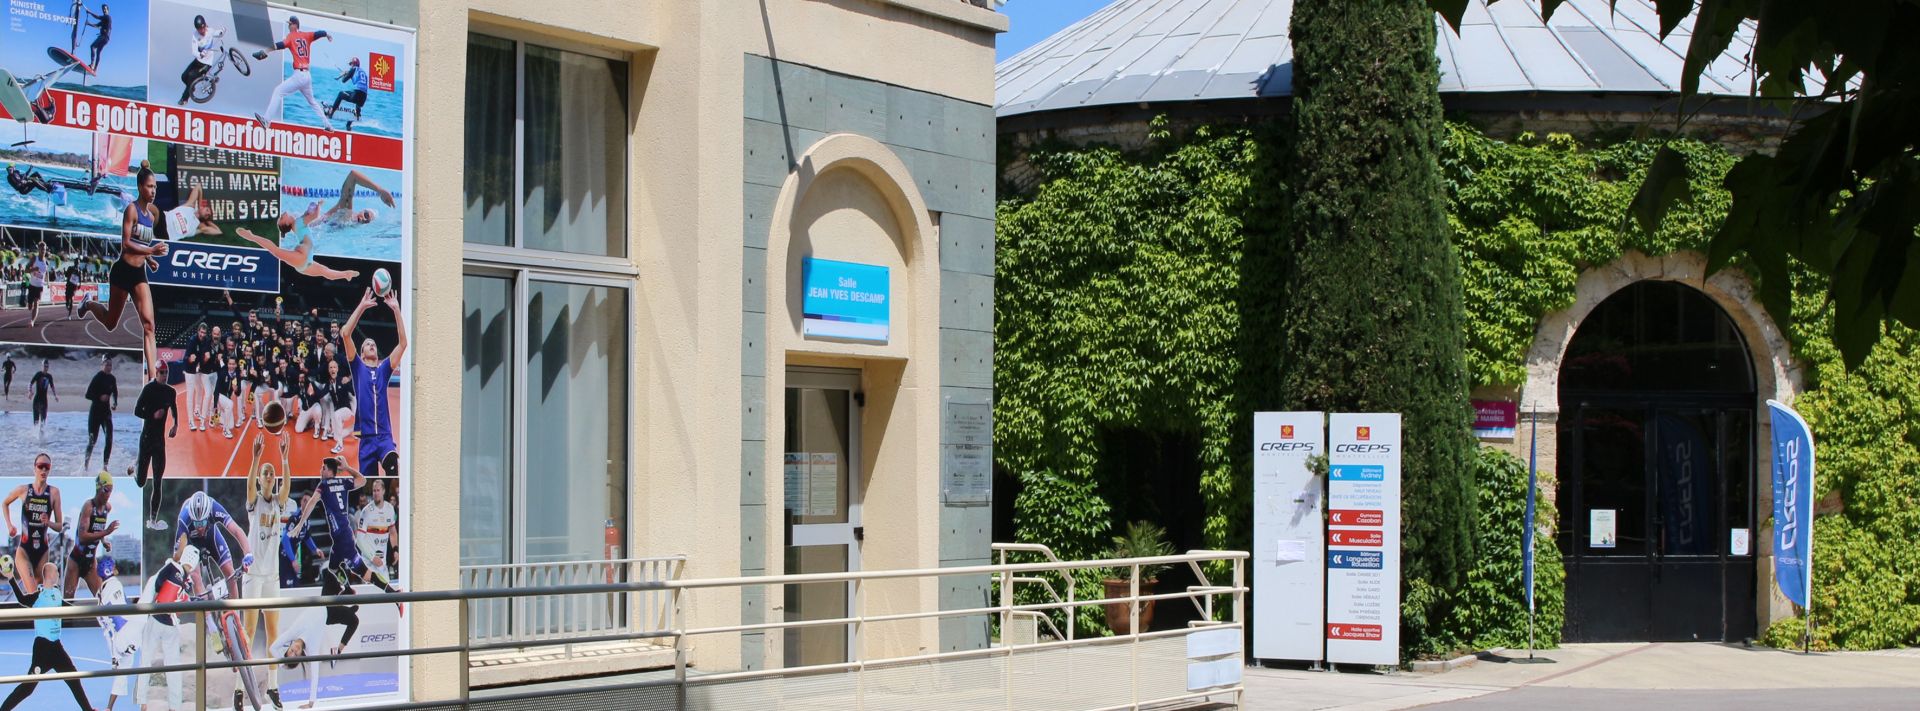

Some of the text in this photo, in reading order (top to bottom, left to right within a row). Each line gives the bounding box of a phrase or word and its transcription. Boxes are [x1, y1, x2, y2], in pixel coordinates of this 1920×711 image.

[39, 12, 52, 21] DES
[53, 15, 77, 25] SPORTS
[296, 38, 308, 57] 21
[65, 94, 91, 126] Le
[96, 102, 148, 135] goût
[152, 108, 180, 140] de
[185, 112, 205, 143] la
[209, 119, 342, 160] performance
[184, 146, 274, 169] DECATHLON
[177, 170, 278, 192] Kevin MAYER
[210, 199, 279, 221] WR 9126
[171, 249, 260, 273] CREPS
[172, 270, 256, 284] MONTPELLIER
[838, 276, 857, 289] Salle
[807, 287, 885, 305] JEAN YVES DESCAMP
[1261, 442, 1315, 451] CREPS
[1335, 444, 1392, 453] CREPS
[335, 492, 345, 510] 5
[360, 632, 397, 643] CREPS
